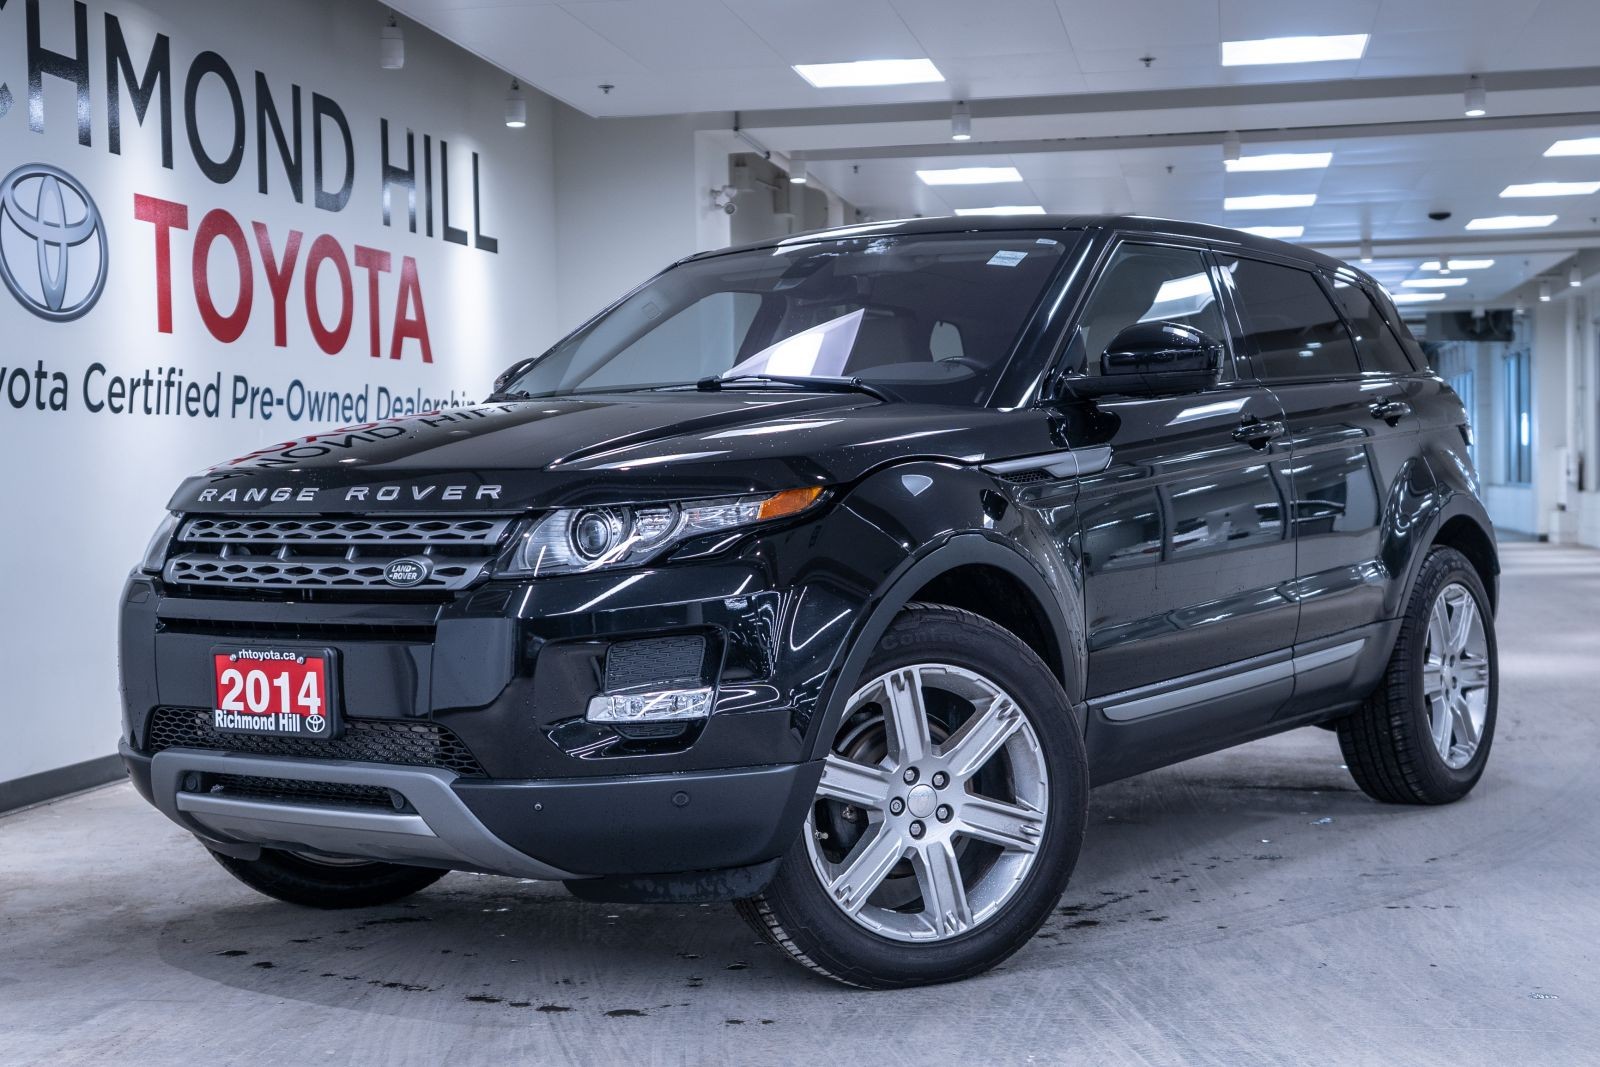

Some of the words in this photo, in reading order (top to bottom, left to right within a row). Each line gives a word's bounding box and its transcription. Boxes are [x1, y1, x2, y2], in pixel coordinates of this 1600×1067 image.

[0, 0, 355, 213] HMOND
[380, 117, 498, 254] HILL
[133, 192, 434, 364] TOYOTA
[83, 362, 220, 418] Certified
[231, 375, 368, 423] Pre-Owned
[198, 487, 319, 502] RANGE
[345, 484, 502, 500] ROVER
[391, 565, 412, 573] LAND
[392, 572, 418, 580] ROVER
[238, 649, 296, 661] rhtoyota.ca
[220, 668, 321, 715] 2014
[215, 709, 275, 731] Richmond
[279, 713, 300, 732] Hill
